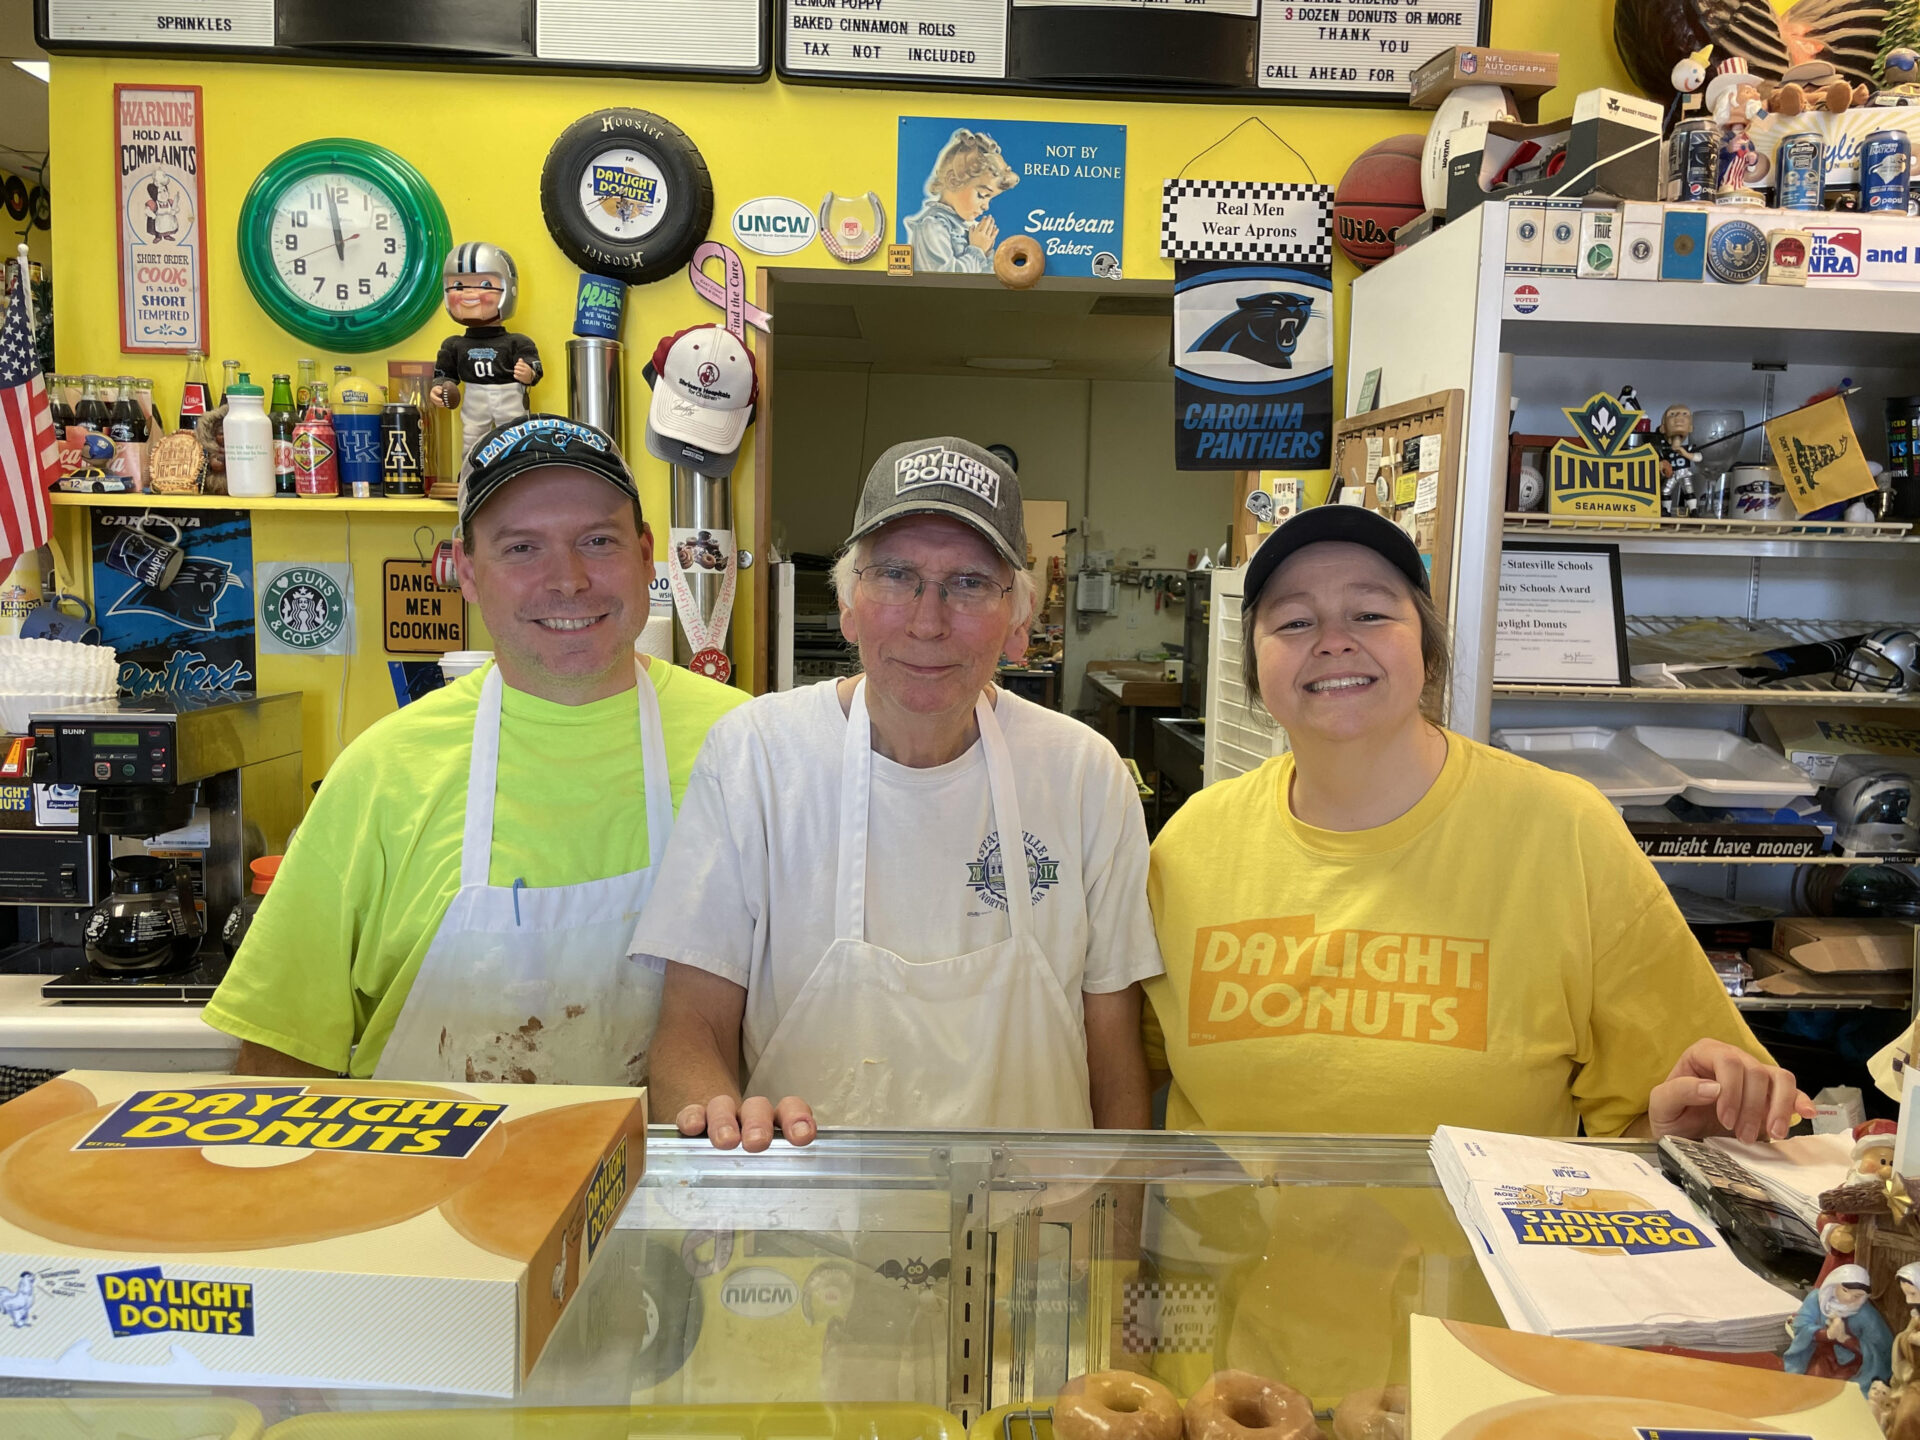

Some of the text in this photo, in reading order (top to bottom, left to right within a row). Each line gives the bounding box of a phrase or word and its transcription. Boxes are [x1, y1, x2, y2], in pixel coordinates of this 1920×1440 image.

[157, 16, 232, 31] SPRINKLES
[1285, 8, 1463, 25] 3 DOZEN DONUTS OR MORE
[793, 16, 956, 37] BAKED CINNAMON ROLLS
[1318, 27, 1370, 41] THANK
[804, 42, 976, 63] TAX NOT INCLUDED
[1380, 40, 1409, 53] YOU
[1266, 65, 1394, 81] CALL AHEAD FOR
[1485, 63, 1546, 73] AUTOGRAPH
[121, 101, 194, 127] WARNING
[133, 129, 182, 141] HOLD ALL
[601, 116, 664, 140] Hoosier
[121, 144, 197, 176] COMPLAINTS
[1046, 145, 1098, 160] NOT BY
[596, 168, 656, 191] DAYLIGHT
[1024, 163, 1121, 179] BREAD ALONE
[310, 186, 368, 211] 11 12 1
[1216, 201, 1285, 216] Real Men
[291, 210, 389, 230] 10 2
[738, 215, 810, 234] UNCW
[1024, 209, 1115, 235] Sunbeam
[1202, 222, 1297, 239] Wear Aprons
[1594, 224, 1612, 239] TRUE
[285, 234, 396, 254] 9 3
[1045, 238, 1094, 257] Bakers
[1812, 245, 1836, 256] the
[137, 253, 189, 265] SHORT ORDER
[1866, 246, 1907, 263] and
[294, 258, 389, 278] 8 4
[1808, 256, 1854, 273] NRA
[137, 267, 187, 287] COOK
[730, 261, 740, 288] Cure
[313, 276, 371, 295] 7 5
[336, 284, 349, 300] 6
[142, 295, 186, 307] SHORT
[579, 283, 621, 311] CRAZY
[730, 291, 740, 308] the
[138, 309, 190, 321] TEMPERED
[582, 319, 601, 327] TRAIN
[596, 313, 612, 321] WILL
[474, 361, 495, 378] 01
[1184, 403, 1304, 429] CAROLINA
[335, 430, 381, 463] UK
[476, 419, 608, 467] PANTHERS
[1196, 431, 1324, 460] PANTHERS
[899, 452, 998, 486] DAYLIGHT
[1555, 455, 1657, 495] UNCW
[904, 467, 991, 498] DONUTS
[1575, 502, 1636, 512] SEAHAWKS
[1507, 560, 1593, 571] Statesville Schools
[271, 572, 336, 597] I GUNS
[1520, 584, 1591, 595] Schools Award
[406, 599, 441, 616] MEN
[270, 620, 338, 646] & COFFEE
[390, 622, 460, 641] COOKING
[1498, 619, 1567, 630] aylight Donuts
[118, 650, 252, 698] Panthers
[1659, 837, 1814, 857] might have money.
[1044, 865, 1055, 879] 17
[979, 891, 1005, 912] NORTH
[1201, 930, 1485, 989] DAYLIGHT
[1208, 981, 1460, 1042] DONUTS
[130, 1092, 499, 1127] DAYLIGHT
[123, 1116, 450, 1153] DONUTS
[588, 1143, 626, 1221] DAYLIGHT
[1501, 1184, 1528, 1193] ABOUT
[591, 1173, 624, 1245] DONUTS
[1521, 1210, 1671, 1227] DONUTS
[1522, 1224, 1700, 1246] DAYLIGHT
[105, 1276, 250, 1308] DAYLIGHT
[120, 1304, 242, 1334] DONUTS
